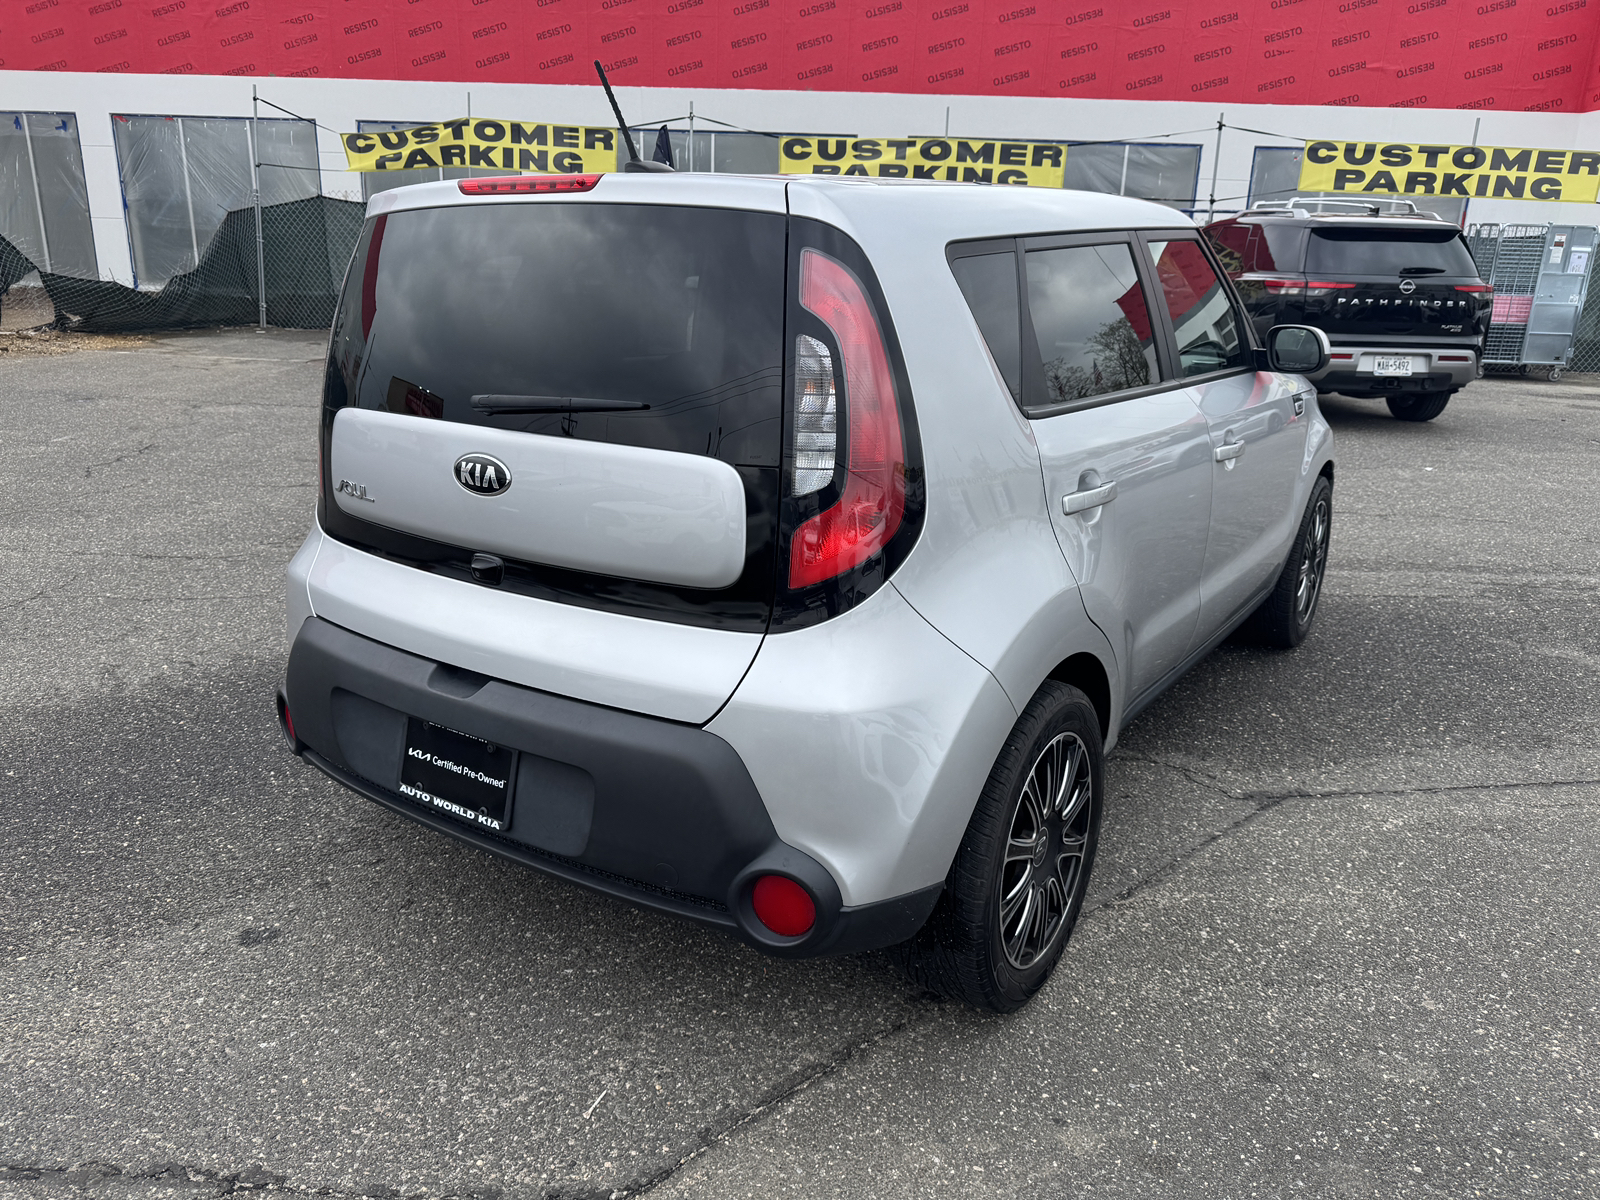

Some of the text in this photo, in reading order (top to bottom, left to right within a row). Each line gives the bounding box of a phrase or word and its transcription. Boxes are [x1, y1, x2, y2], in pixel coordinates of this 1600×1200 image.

[151, 1, 185, 17] RESISTO
[215, 1, 249, 17] RESISTO
[602, 0, 639, 10] SISTO
[733, 0, 770, 16] RESISTO
[799, 1, 836, 17] RESISTO
[865, 2, 902, 18] RESISTO
[931, 4, 969, 20] RESISTO
[1477, 0, 1517, 15] RESISTO
[1546, 0, 1586, 16] RESISTO
[279, 13, 315, 25] SISTO
[998, 6, 1036, 22] RESISTO
[1065, 9, 1103, 25] RESISTO
[1133, 10, 1170, 27] RESISTO
[1199, 12, 1238, 28] RESISTO
[343, 19, 378, 35] RESISTO
[407, 21, 442, 38] RESISTO
[471, 22, 507, 39] RESISTO
[535, 24, 572, 40] RESISTO
[600, 26, 636, 43] RESISTO
[1263, 27, 1302, 43] RESISTO
[31, 28, 64, 43] RESISTO
[93, 29, 127, 44] RESISTO
[157, 31, 190, 46] RESISTO
[220, 32, 253, 47] RESISTO
[283, 34, 318, 50] RESISTO
[665, 31, 702, 47] RESISTO
[730, 33, 767, 49] RESISTO
[796, 35, 832, 51] RESISTO
[1331, 31, 1370, 47] RESISTO
[1399, 32, 1438, 48] RESISTO
[1468, 33, 1508, 50] RESISTO
[1537, 34, 1577, 51] RESISTO
[861, 36, 898, 52] RESISTO
[927, 38, 964, 54] RESISTO
[993, 40, 1031, 56] RESISTO
[1060, 42, 1098, 59] RESISTO
[347, 48, 382, 64] RESISTO
[411, 50, 446, 67] RESISTO
[475, 52, 510, 68] RESISTO
[1127, 45, 1165, 61] RESISTO
[1193, 46, 1232, 62] RESISTO
[34, 60, 68, 71] SISTO
[538, 54, 574, 70] RESISTO
[603, 55, 638, 73] RESISTO
[667, 60, 703, 76] RESISTO
[731, 62, 768, 78] RESISTO
[1328, 61, 1366, 77] RESISTO
[1396, 62, 1434, 78] RESISTO
[284, 65, 319, 77] SISTO
[797, 64, 833, 80] RESISTO
[861, 66, 898, 82] RESISTO
[927, 68, 964, 84] RESISTO
[993, 71, 1030, 86] RESISTO
[1463, 64, 1503, 80] RESISTO
[1532, 65, 1571, 81] RESISTO
[1059, 72, 1096, 88] RESISTO
[1125, 75, 1163, 90] RESISTO
[1191, 77, 1228, 92] RESISTO
[1257, 76, 1295, 92] RESISTO
[1321, 94, 1360, 106] SISTO
[346, 119, 614, 154] CUSTOMER
[375, 145, 585, 173] PARKING
[782, 138, 1063, 168] CUSTOMER
[1306, 141, 1600, 175] CUSTOMER
[1333, 168, 1563, 200] PARKING
[1337, 297, 1466, 308] PATHFINDER
[460, 461, 500, 489] KIA
[335, 479, 375, 503] SOUL
[408, 747, 431, 762] KIA
[432, 755, 462, 774] Certified
[400, 784, 500, 830] AUTO WORLD KIA
